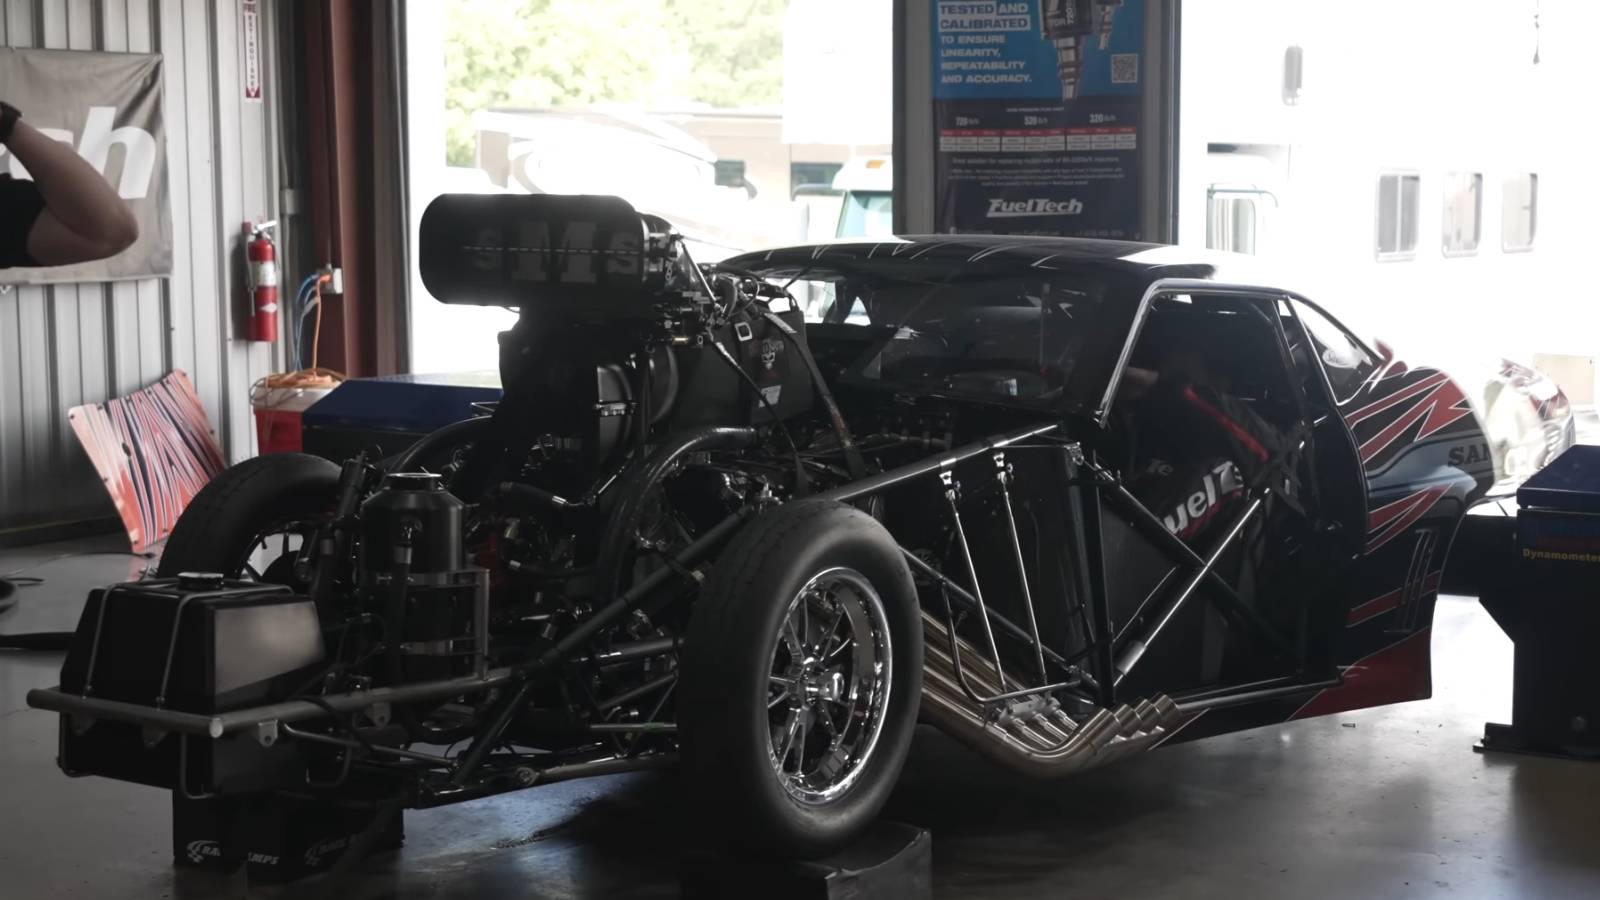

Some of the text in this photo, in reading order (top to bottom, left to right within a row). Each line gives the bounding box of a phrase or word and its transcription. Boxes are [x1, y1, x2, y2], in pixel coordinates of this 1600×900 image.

[940, 3, 1028, 14] TESTED AND
[940, 18, 1028, 29] CALIBRATED
[940, 35, 1006, 44] TO ENSURE
[940, 48, 1001, 57] LINEARITY,
[940, 61, 1025, 70] REPEATABILITY
[940, 74, 1032, 84] AND ACCURACY.
[986, 198, 1083, 217] FuelTech
